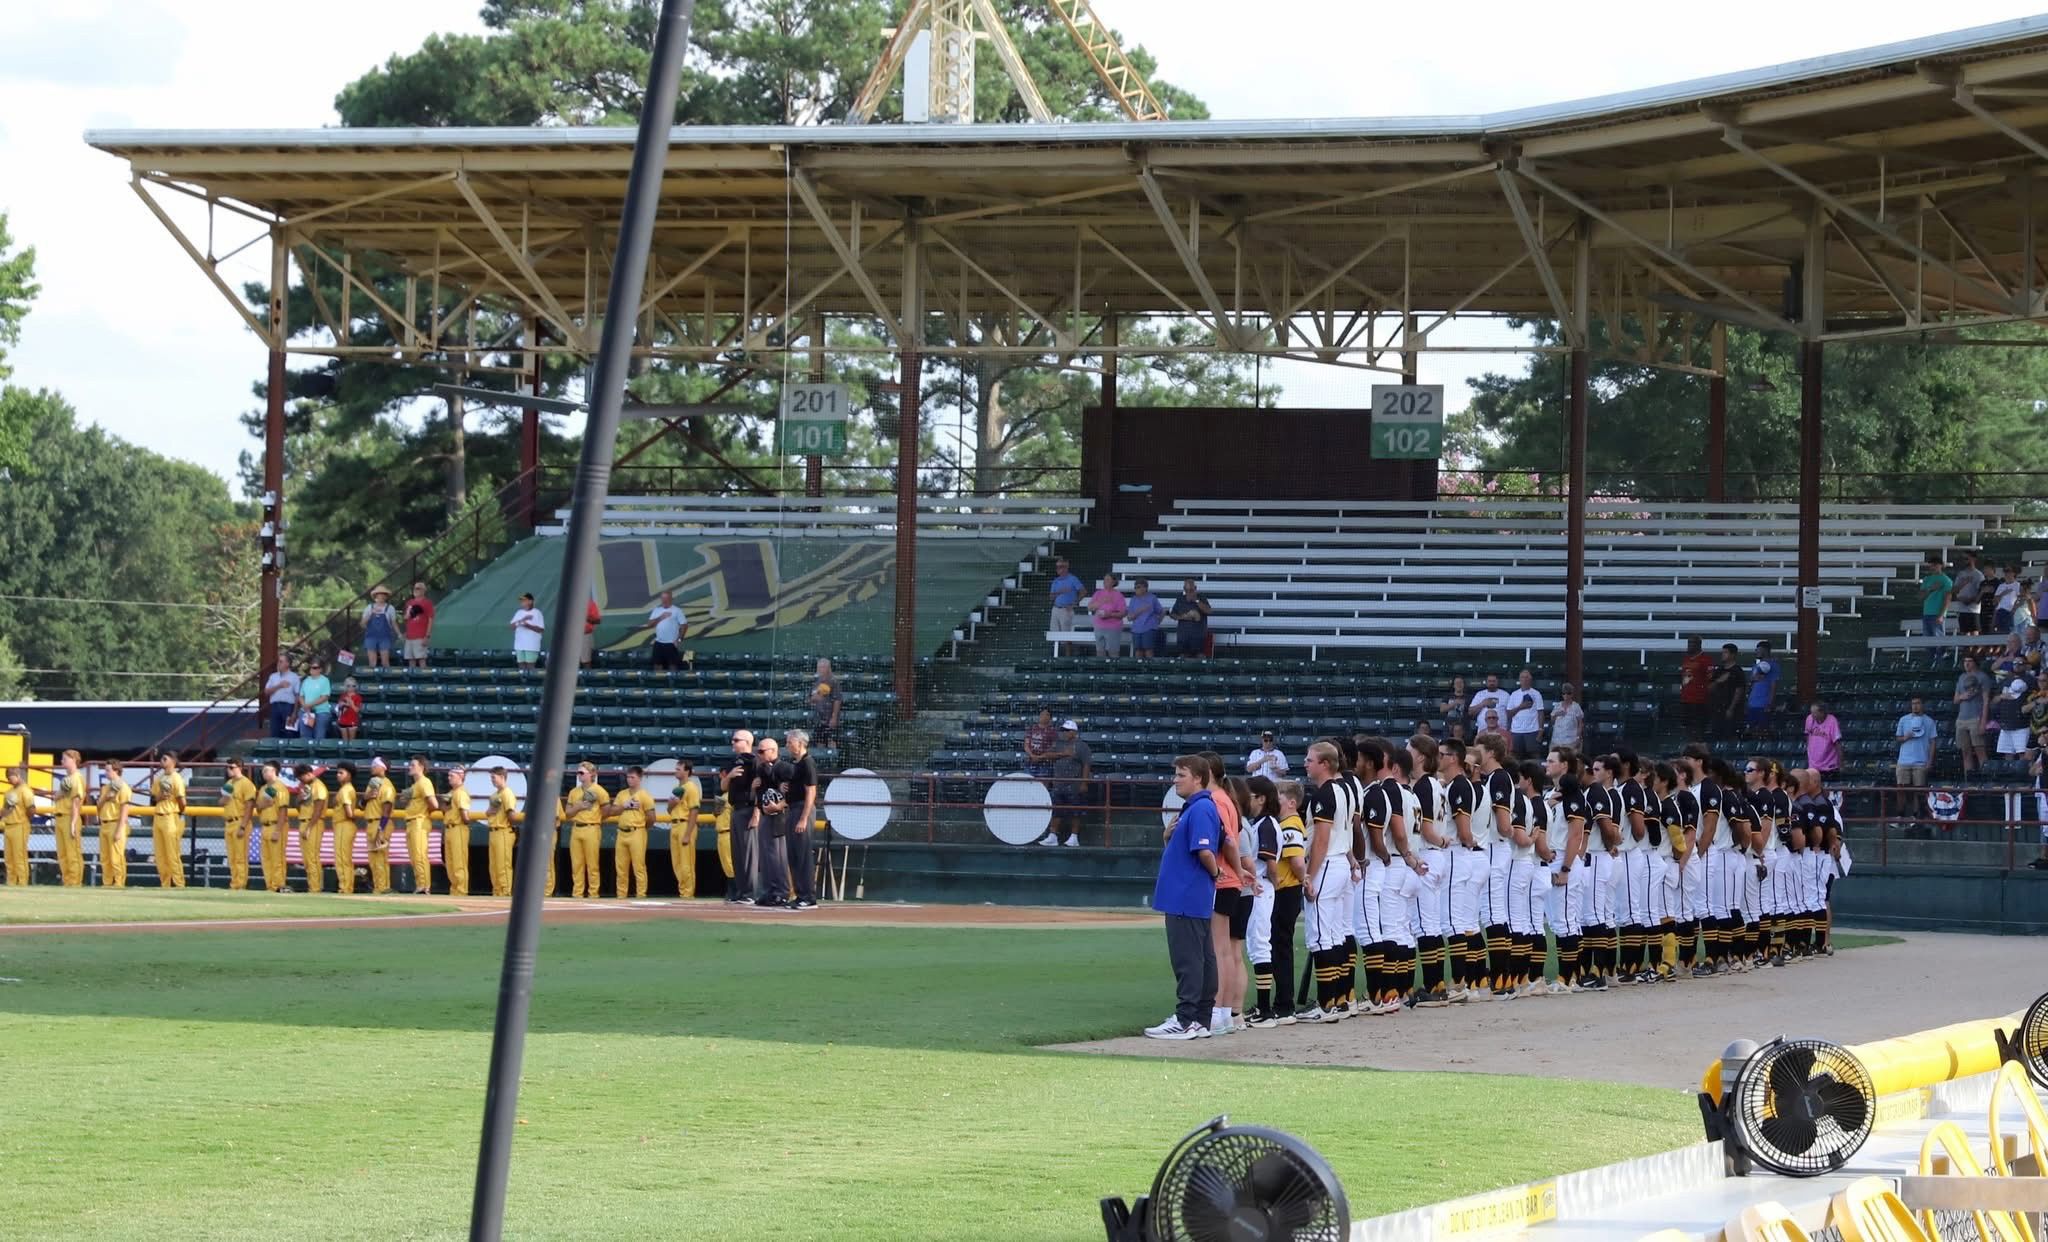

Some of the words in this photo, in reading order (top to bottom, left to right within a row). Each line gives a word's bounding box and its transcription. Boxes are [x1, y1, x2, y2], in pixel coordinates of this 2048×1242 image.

[792, 390, 836, 413] 201
[1382, 391, 1433, 415] 202
[791, 425, 835, 449] 101
[1383, 428, 1431, 453] 102
[1525, 1194, 1538, 1217] BAR
